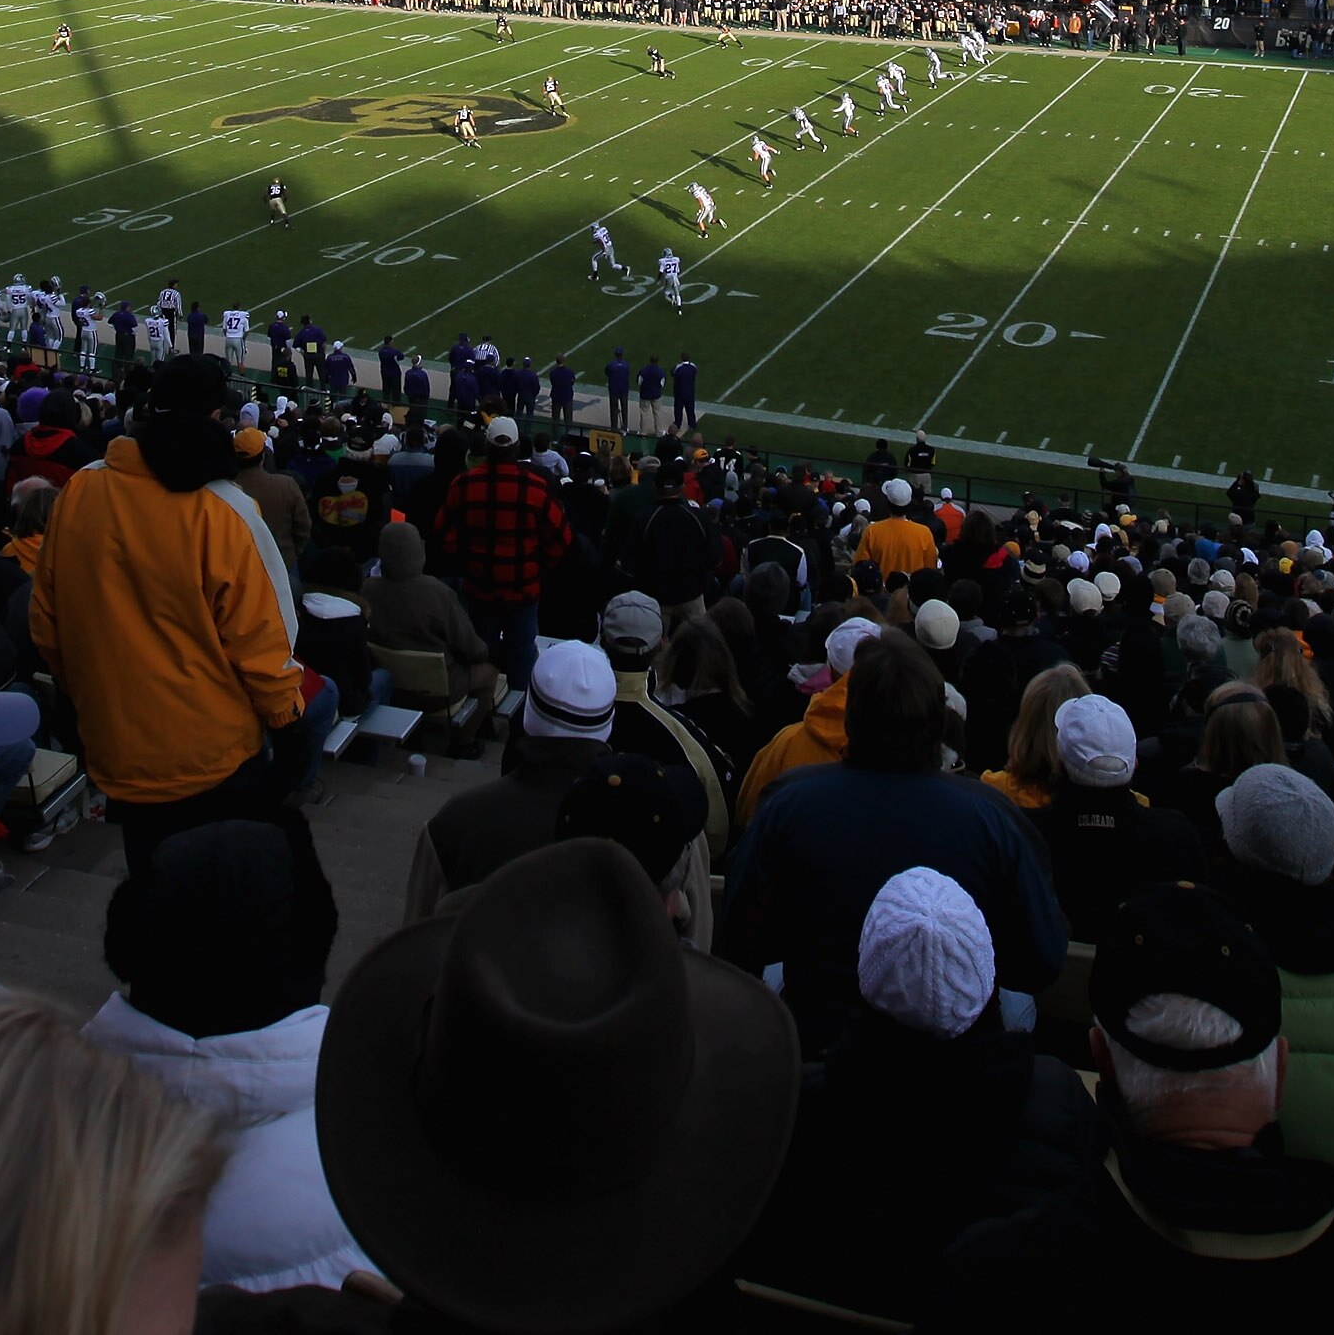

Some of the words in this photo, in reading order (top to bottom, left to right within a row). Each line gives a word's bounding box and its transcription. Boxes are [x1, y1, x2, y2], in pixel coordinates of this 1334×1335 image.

[1213, 17, 1230, 30] 20
[72, 208, 174, 232] 50
[319, 241, 426, 265] 40
[665, 263, 676, 274] 27
[601, 275, 719, 304] 30
[11, 294, 26, 304] 55
[227, 318, 241, 330] 47
[924, 312, 1058, 347] 20
[149, 326, 161, 338] 21
[719, 457, 737, 471] 14
[1077, 814, 1115, 828] COLORADO
